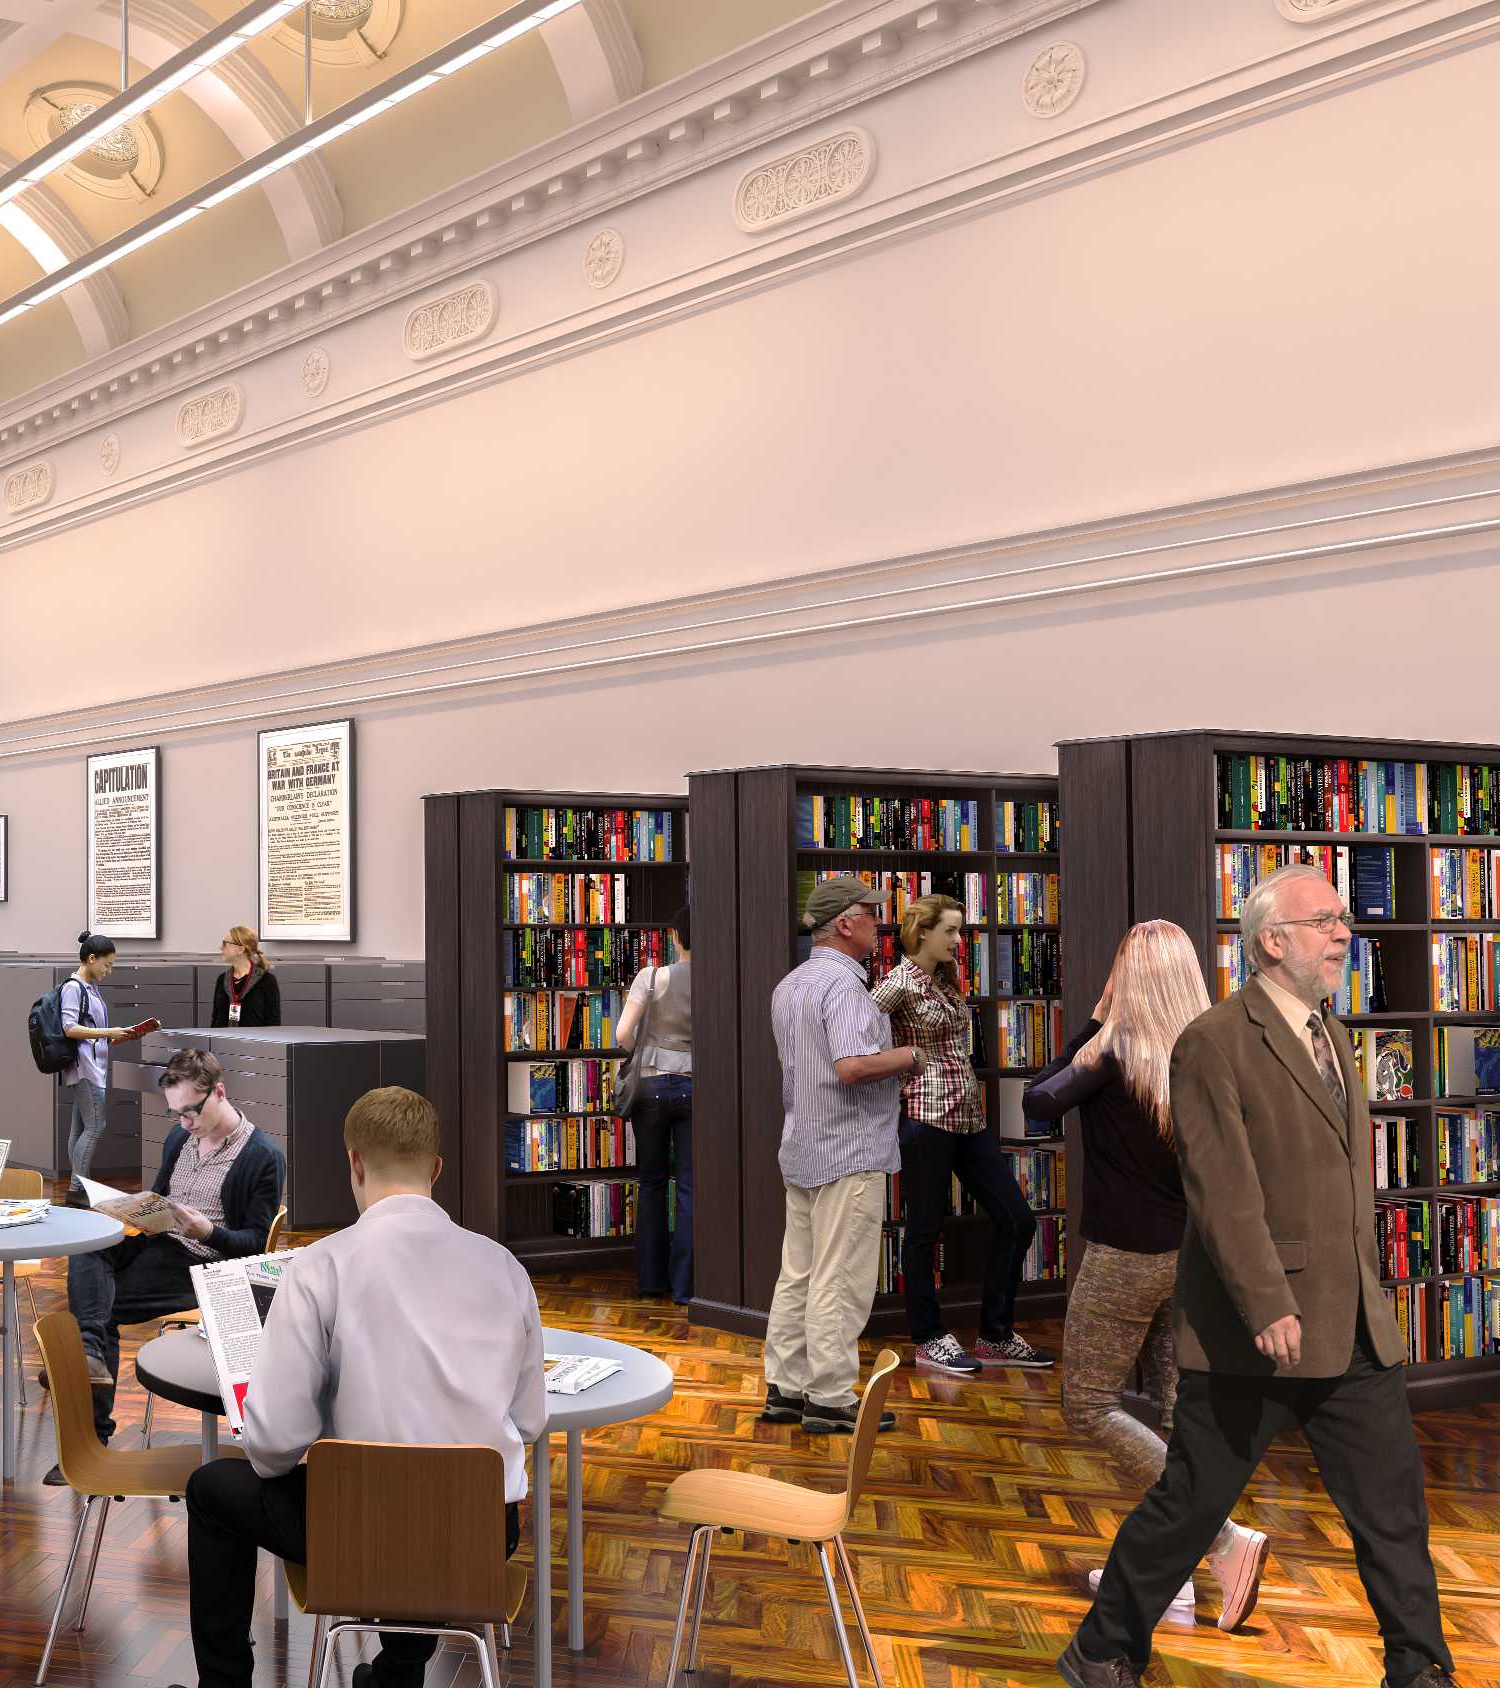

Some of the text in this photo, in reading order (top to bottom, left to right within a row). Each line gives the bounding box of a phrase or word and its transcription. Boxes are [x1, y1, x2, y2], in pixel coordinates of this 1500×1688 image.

[95, 764, 148, 794] CAPITULATION
[268, 761, 340, 780] BRITAIN AND FRANCE AT
[272, 774, 336, 791] WAR WITH GERMANY
[112, 793, 149, 804] ANNOUNCEMENT
[306, 788, 338, 799] DECLARATION
